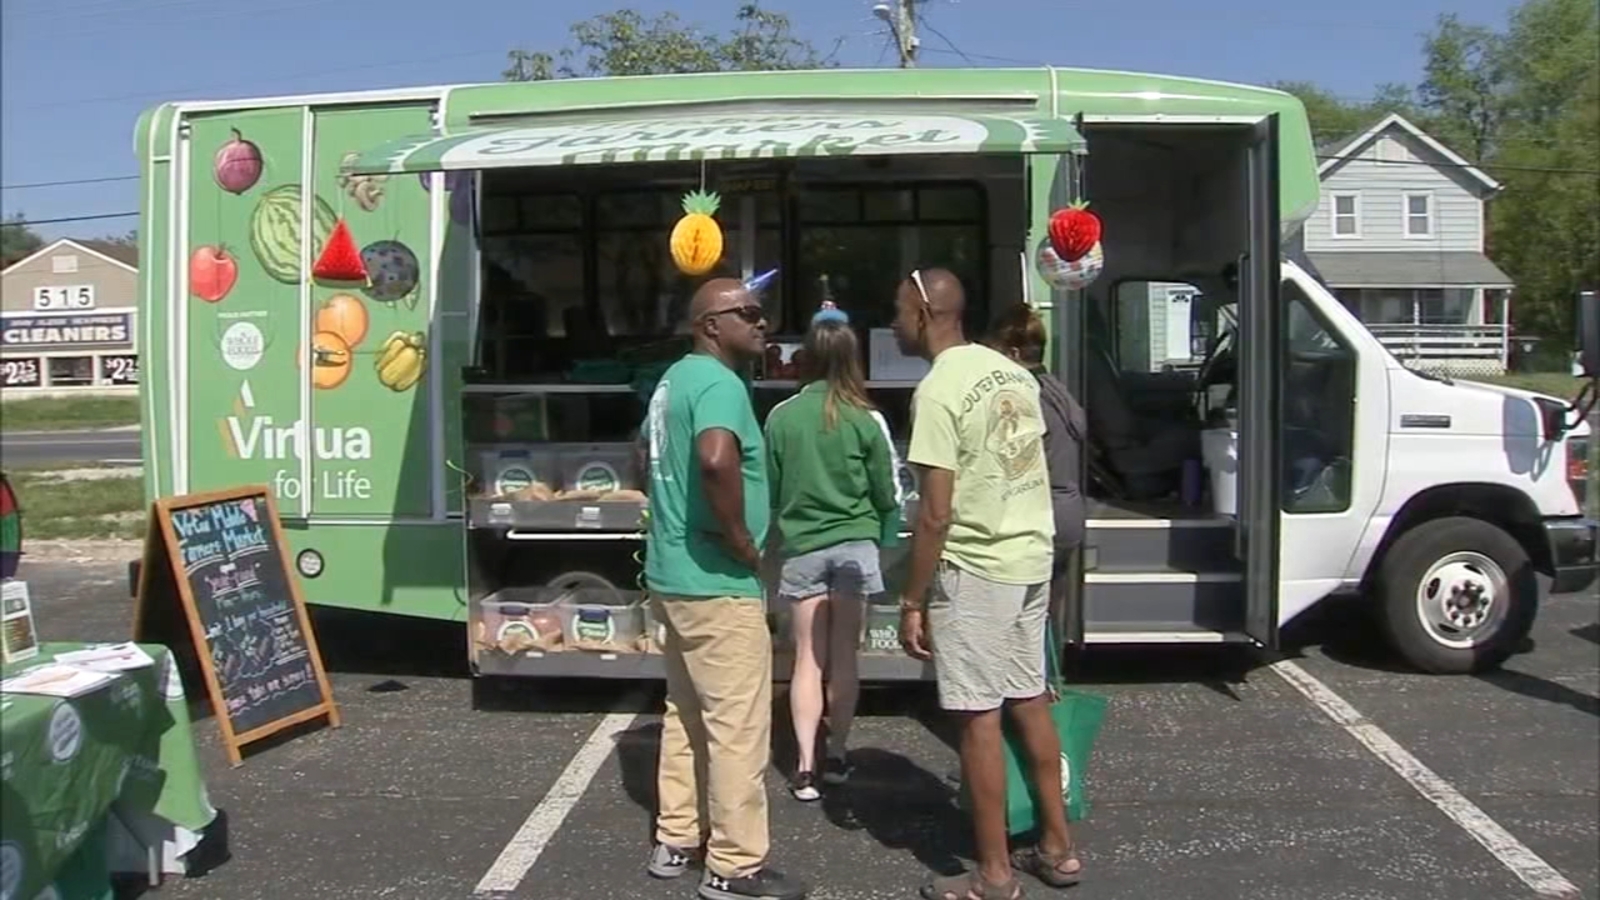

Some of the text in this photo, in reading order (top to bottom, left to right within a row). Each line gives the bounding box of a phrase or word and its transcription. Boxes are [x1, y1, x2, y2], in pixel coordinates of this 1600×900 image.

[38, 287, 91, 307] 515
[3, 325, 126, 343] CLEANERS
[275, 469, 371, 499] fo Life
